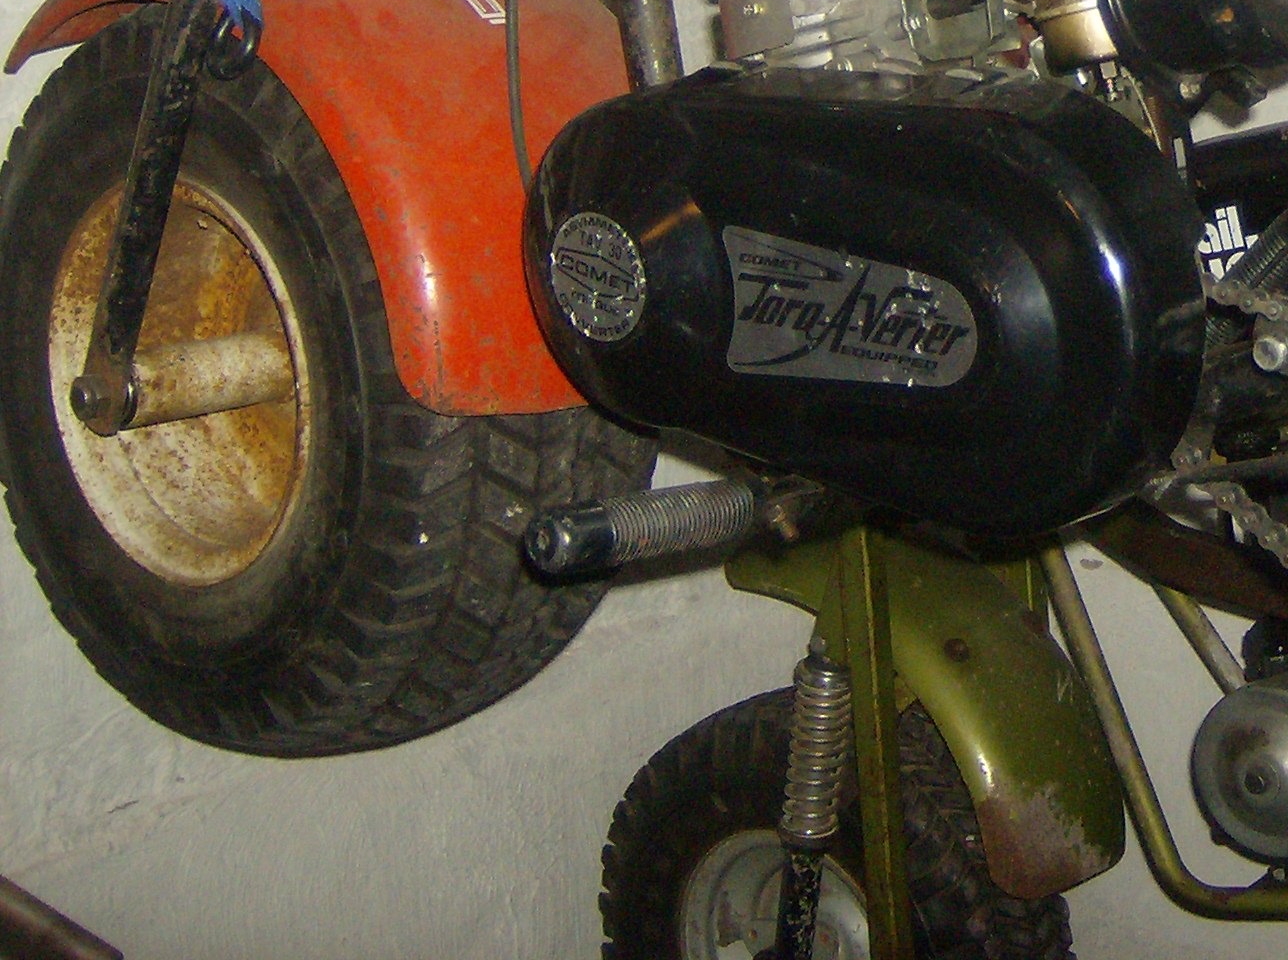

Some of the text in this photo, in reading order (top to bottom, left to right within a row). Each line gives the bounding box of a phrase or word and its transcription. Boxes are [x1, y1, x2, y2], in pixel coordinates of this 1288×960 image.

[559, 253, 636, 294] COMET
[738, 252, 801, 271] COMET
[840, 344, 939, 370] EQUIPPED
